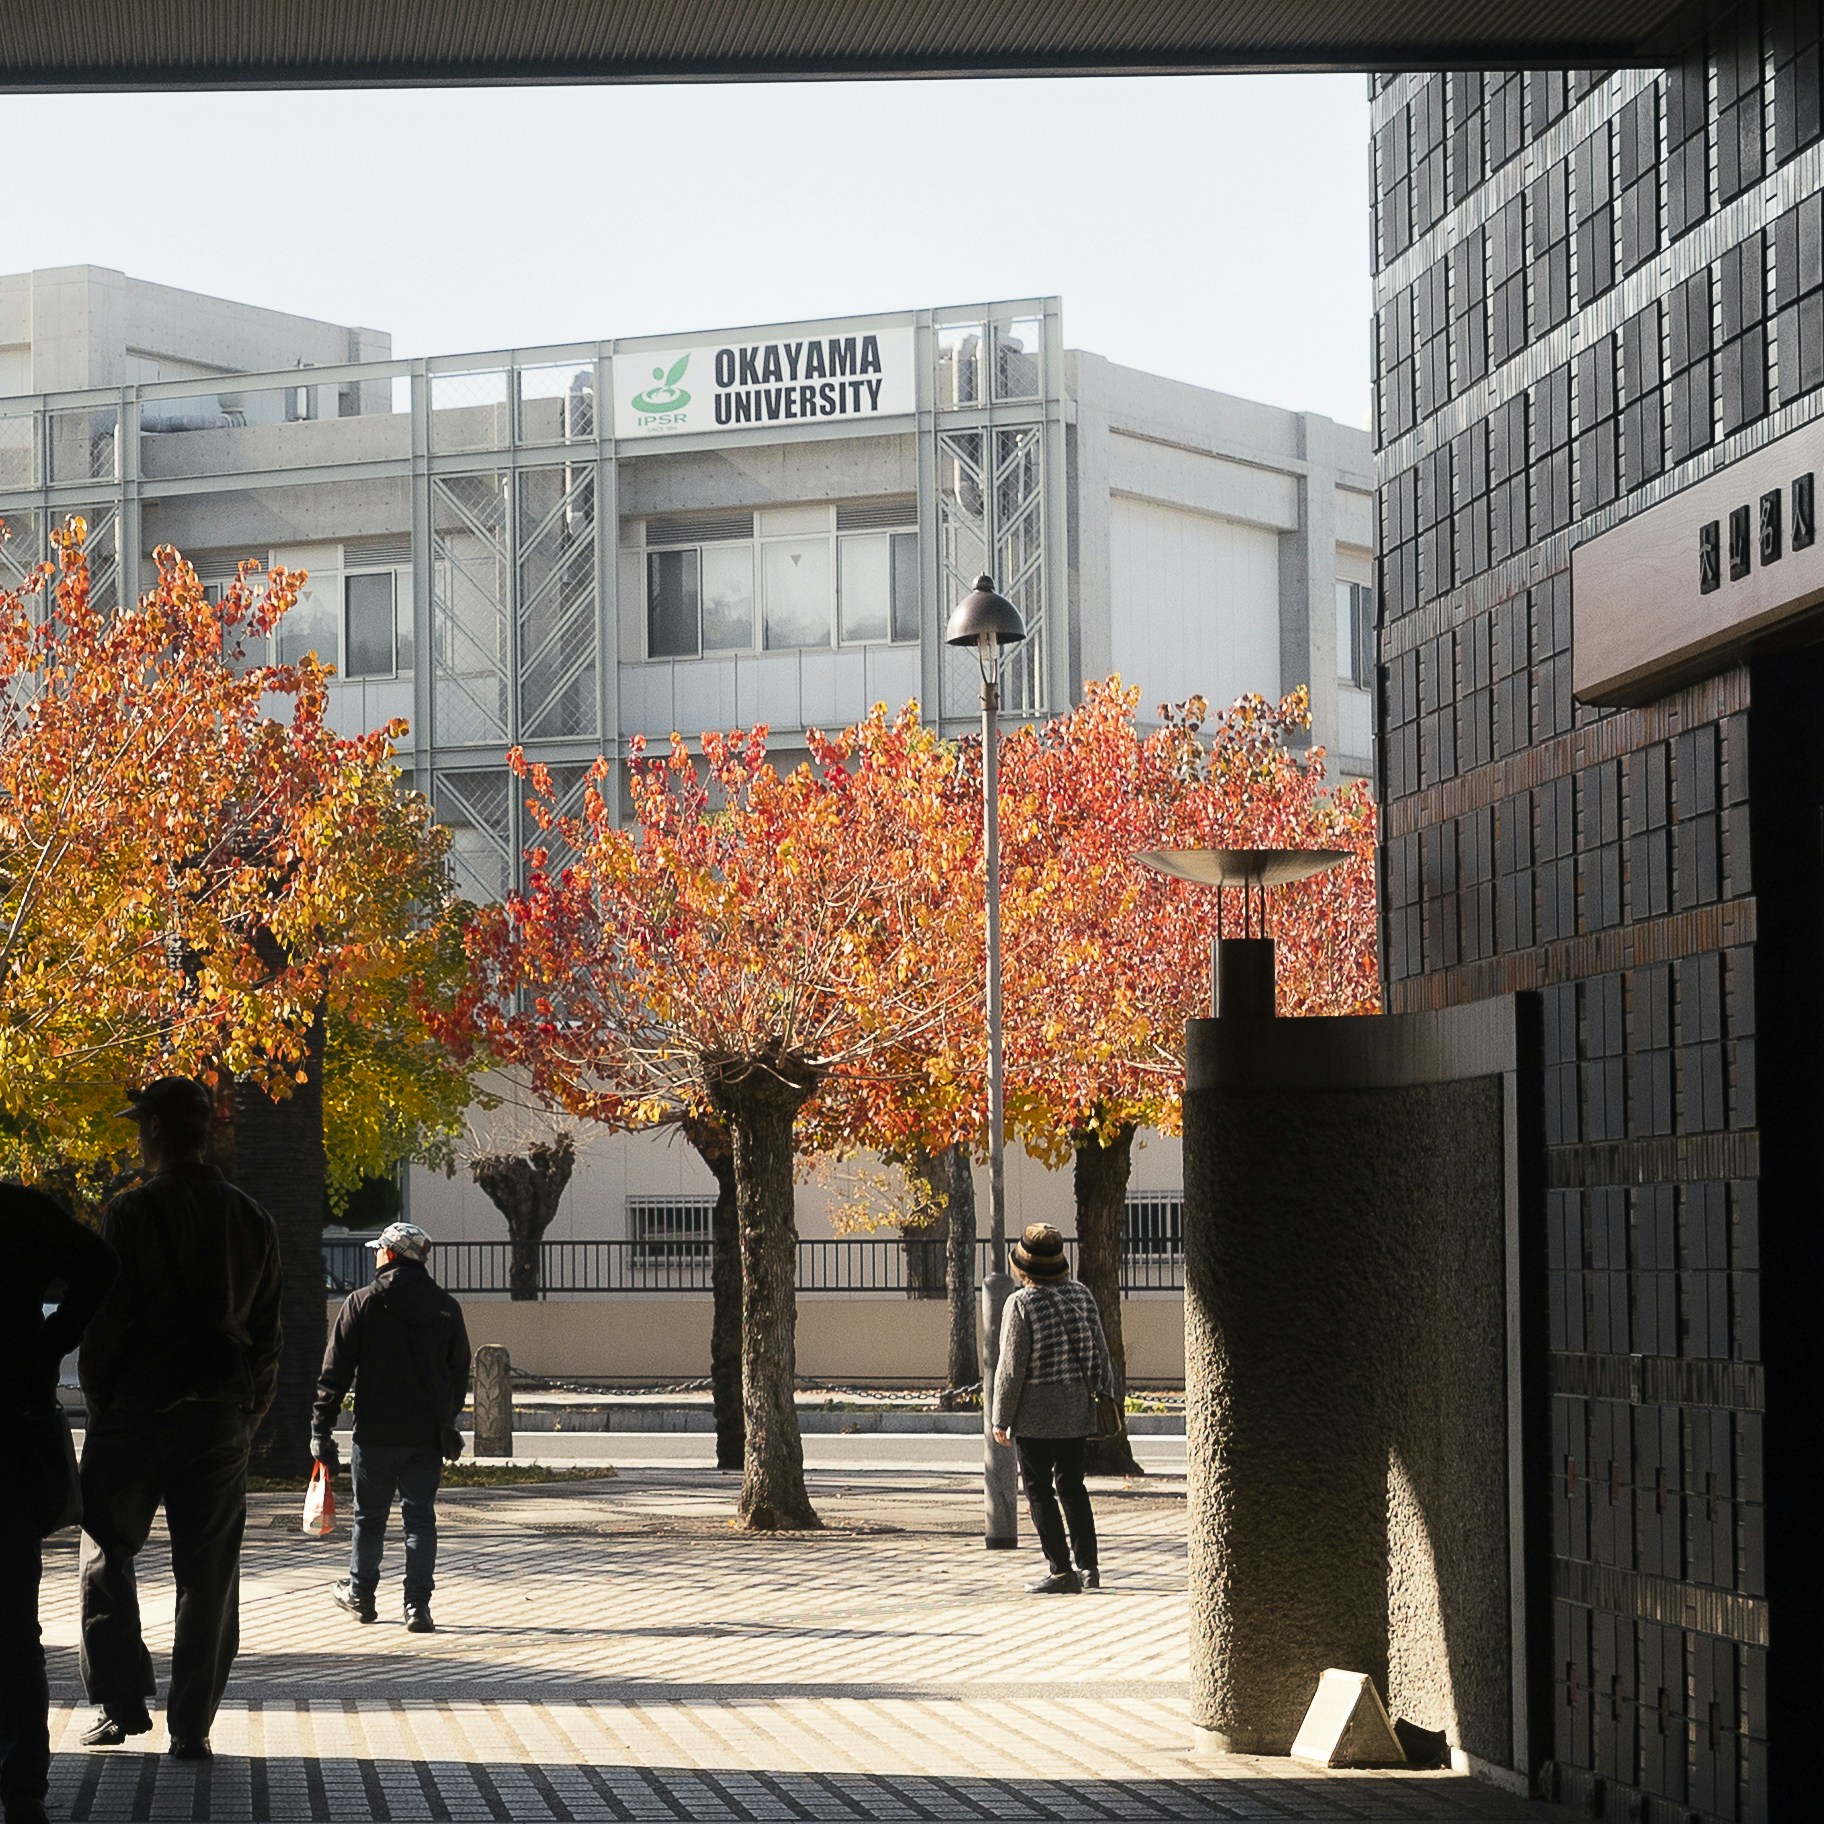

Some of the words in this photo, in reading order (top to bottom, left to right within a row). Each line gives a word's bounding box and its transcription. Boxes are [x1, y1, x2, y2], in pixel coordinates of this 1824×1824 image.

[715, 334, 882, 388] OKAYAMA
[638, 413, 687, 427] IPSR
[714, 378, 883, 425] UNIVERSITY
